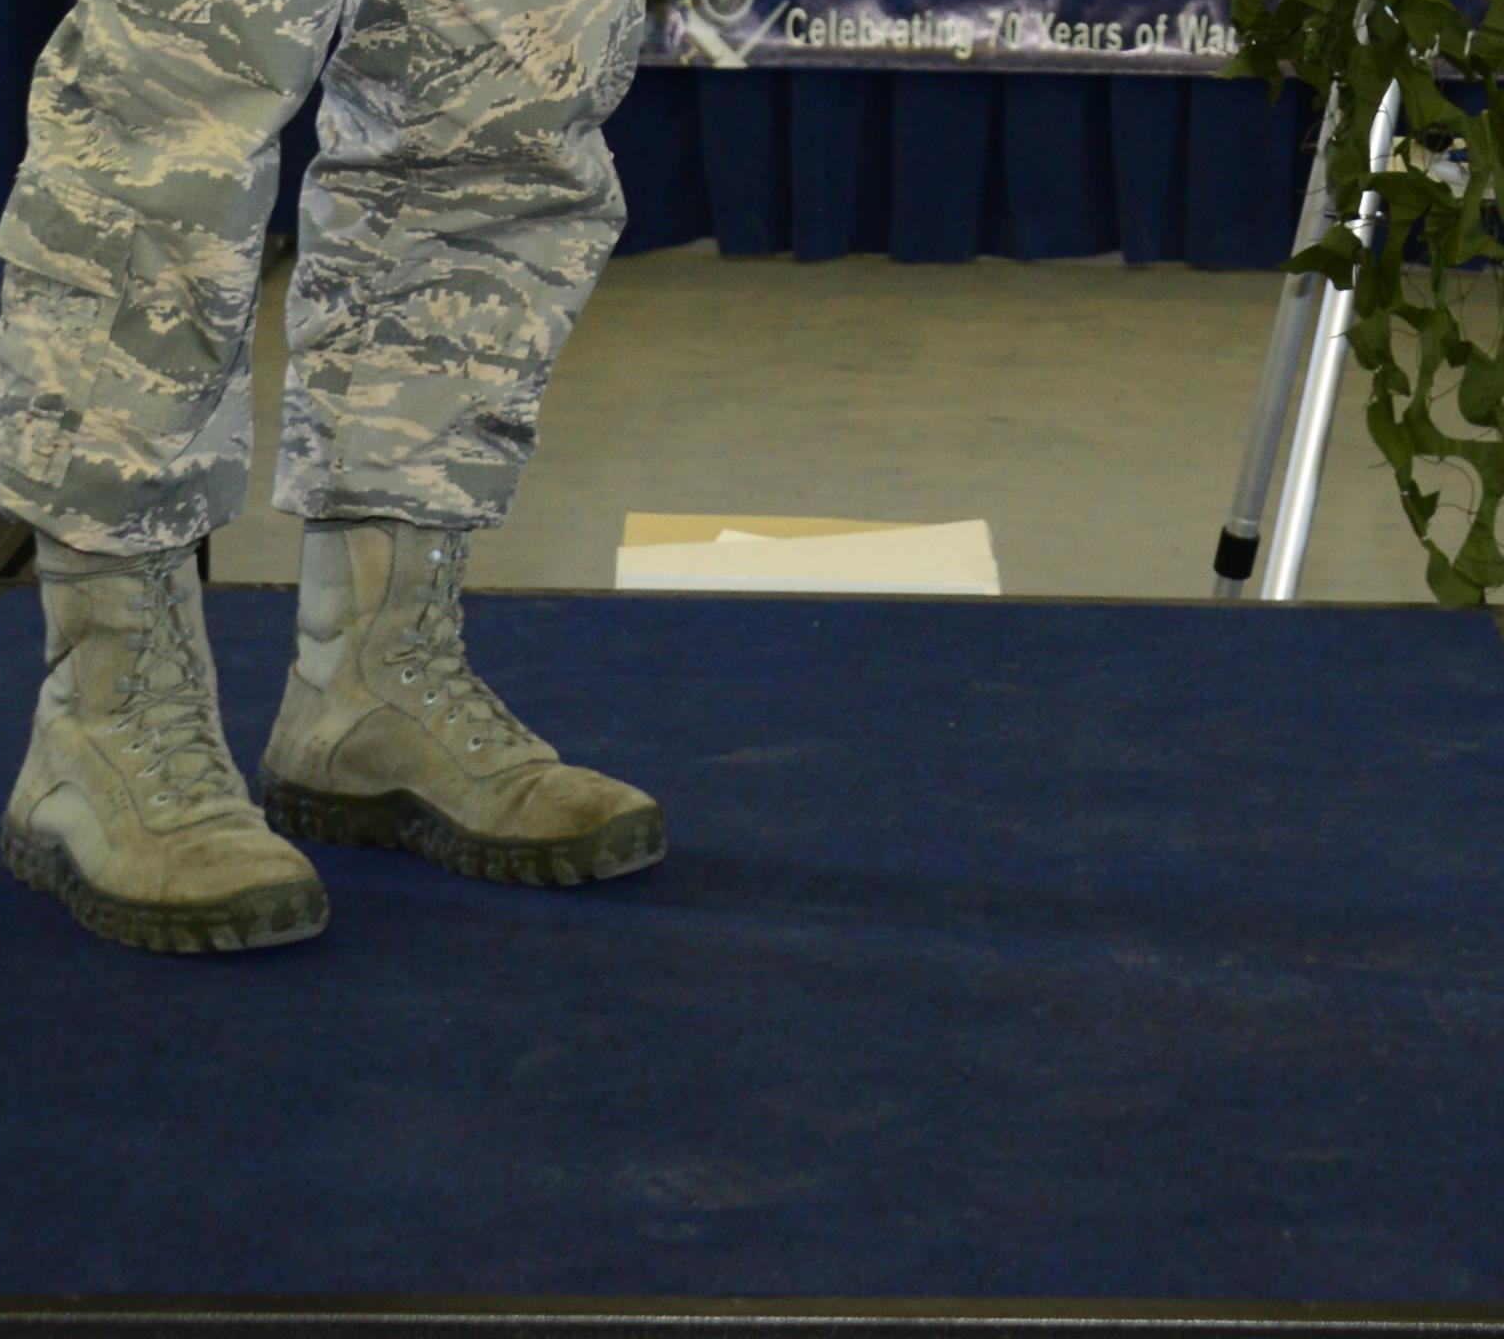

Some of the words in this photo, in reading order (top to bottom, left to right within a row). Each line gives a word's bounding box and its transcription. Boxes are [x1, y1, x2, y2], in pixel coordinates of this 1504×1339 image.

[785, 8, 972, 59] Celebrating
[987, 10, 1023, 51] 70
[1039, 12, 1122, 52] Years
[1136, 13, 1169, 52] of
